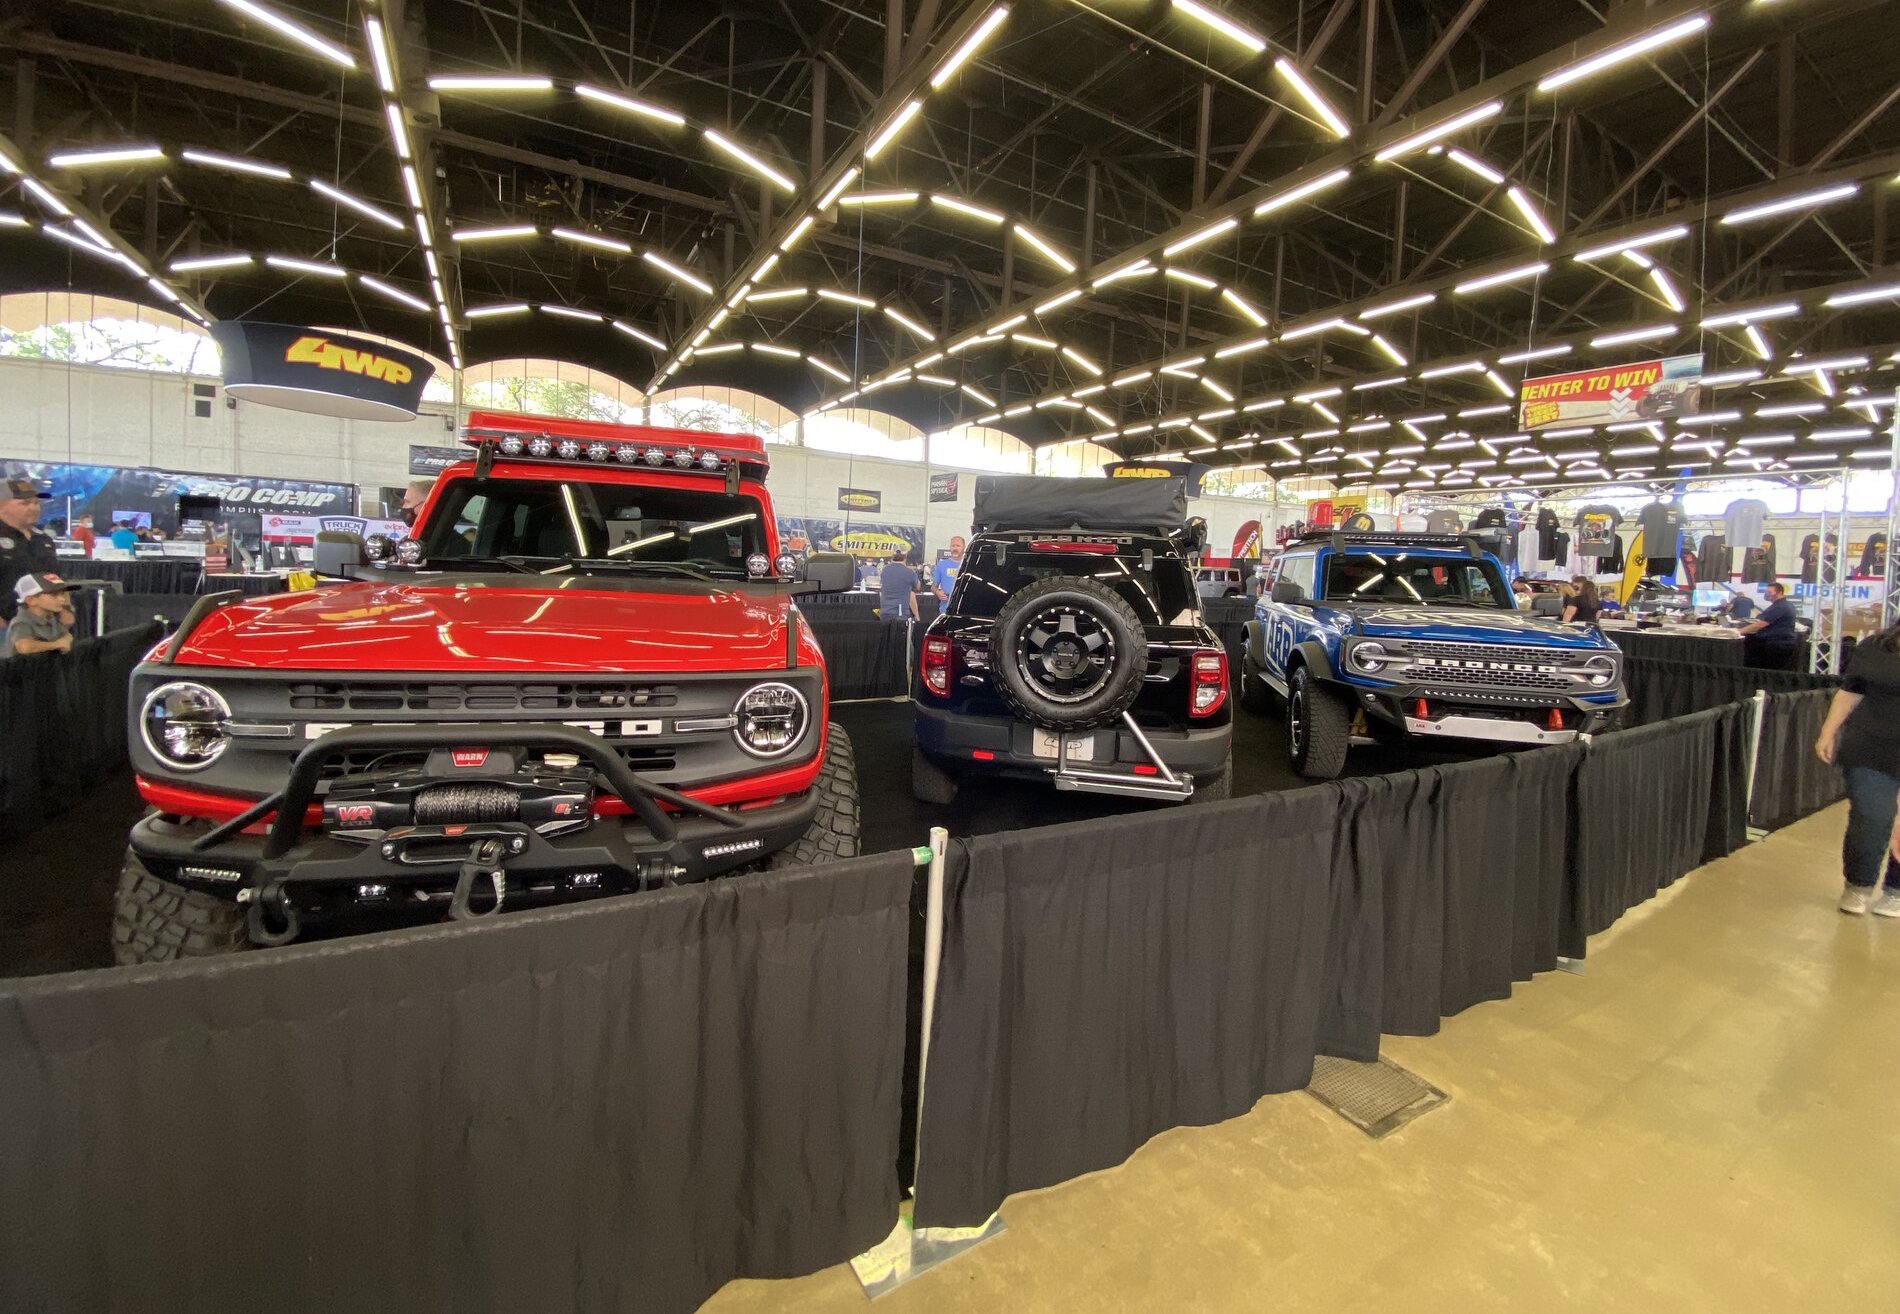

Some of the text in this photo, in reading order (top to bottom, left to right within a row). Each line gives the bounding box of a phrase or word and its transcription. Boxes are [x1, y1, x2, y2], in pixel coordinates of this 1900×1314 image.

[285, 336, 412, 384] 4WP
[1528, 368, 1657, 398] ENTER TO WIN
[251, 488, 336, 507] COMP
[325, 521, 361, 530] TRUCK
[1418, 658, 1557, 673] BRONCO
[456, 752, 484, 762] WARN
[338, 805, 374, 821] VR
